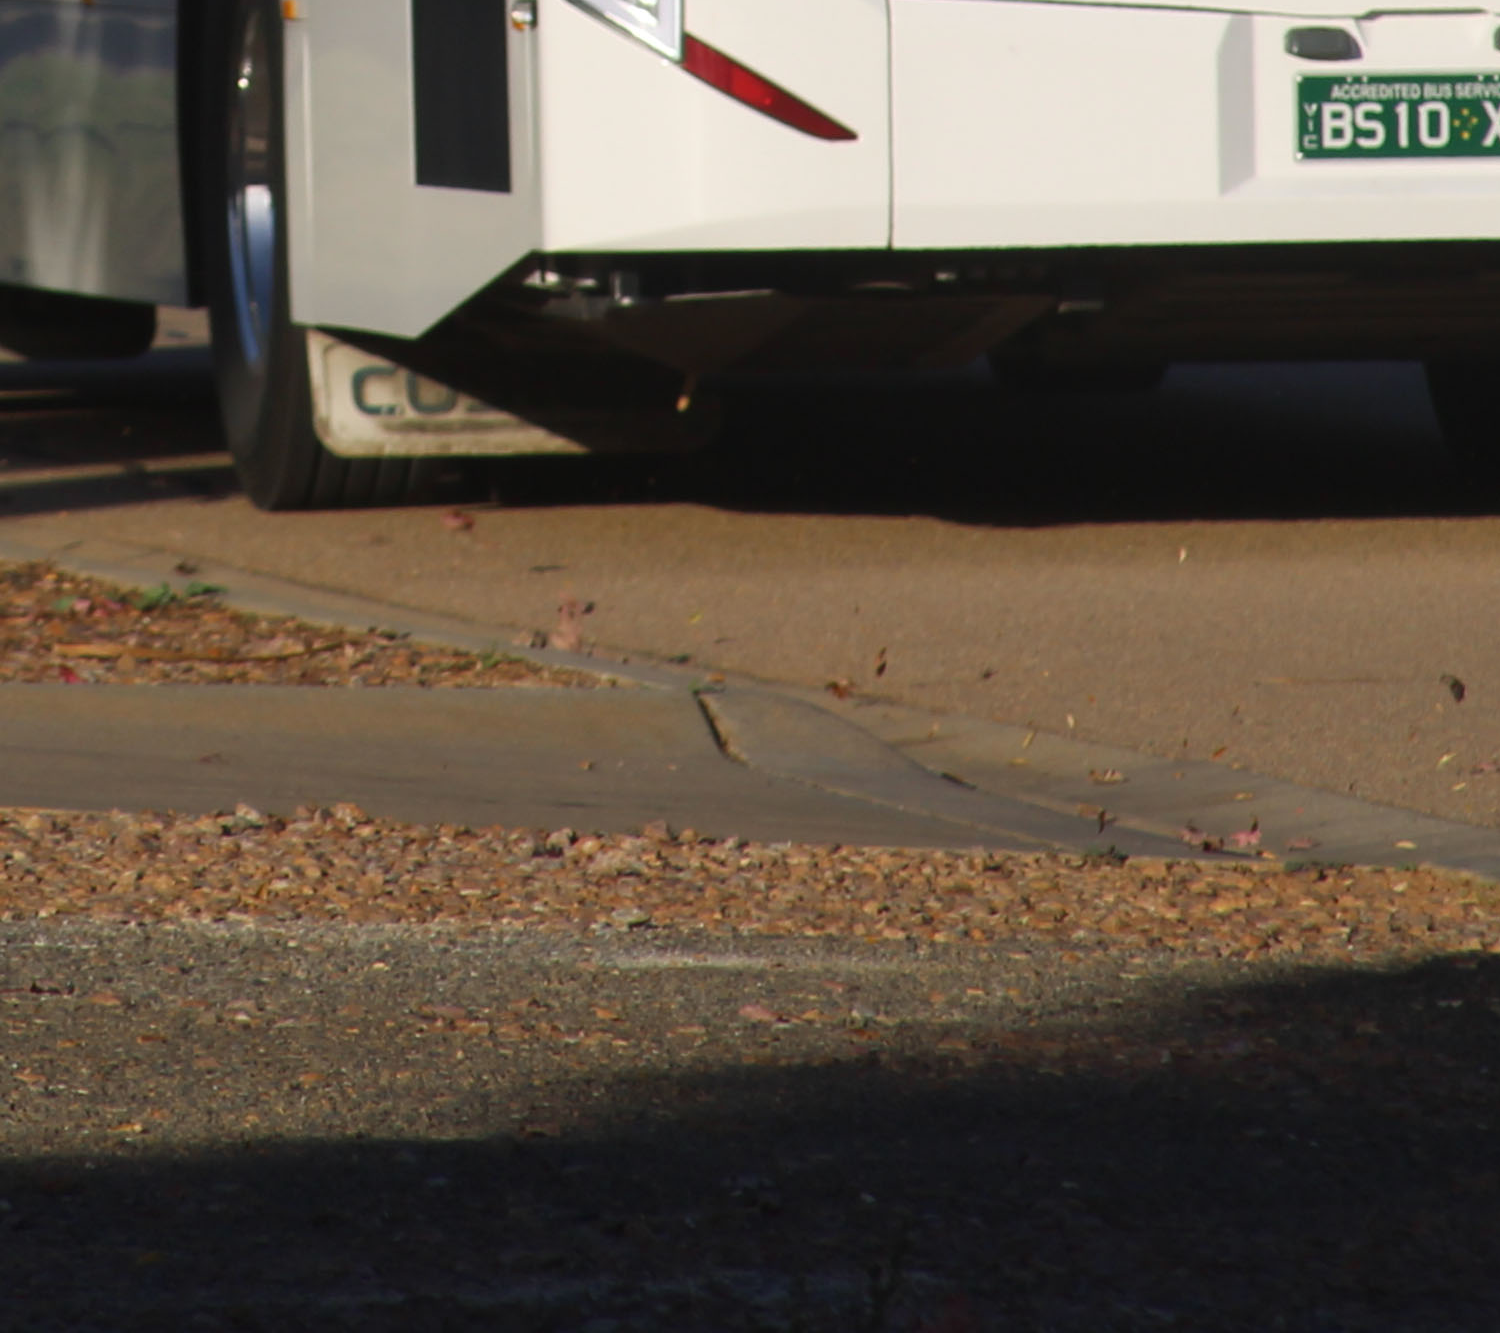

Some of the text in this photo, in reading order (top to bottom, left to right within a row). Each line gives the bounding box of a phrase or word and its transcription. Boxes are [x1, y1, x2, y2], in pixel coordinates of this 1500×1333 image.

[1330, 83, 1421, 101] ACCREDITED
[1423, 83, 1453, 100] BUS
[1320, 101, 1451, 150] BS10
